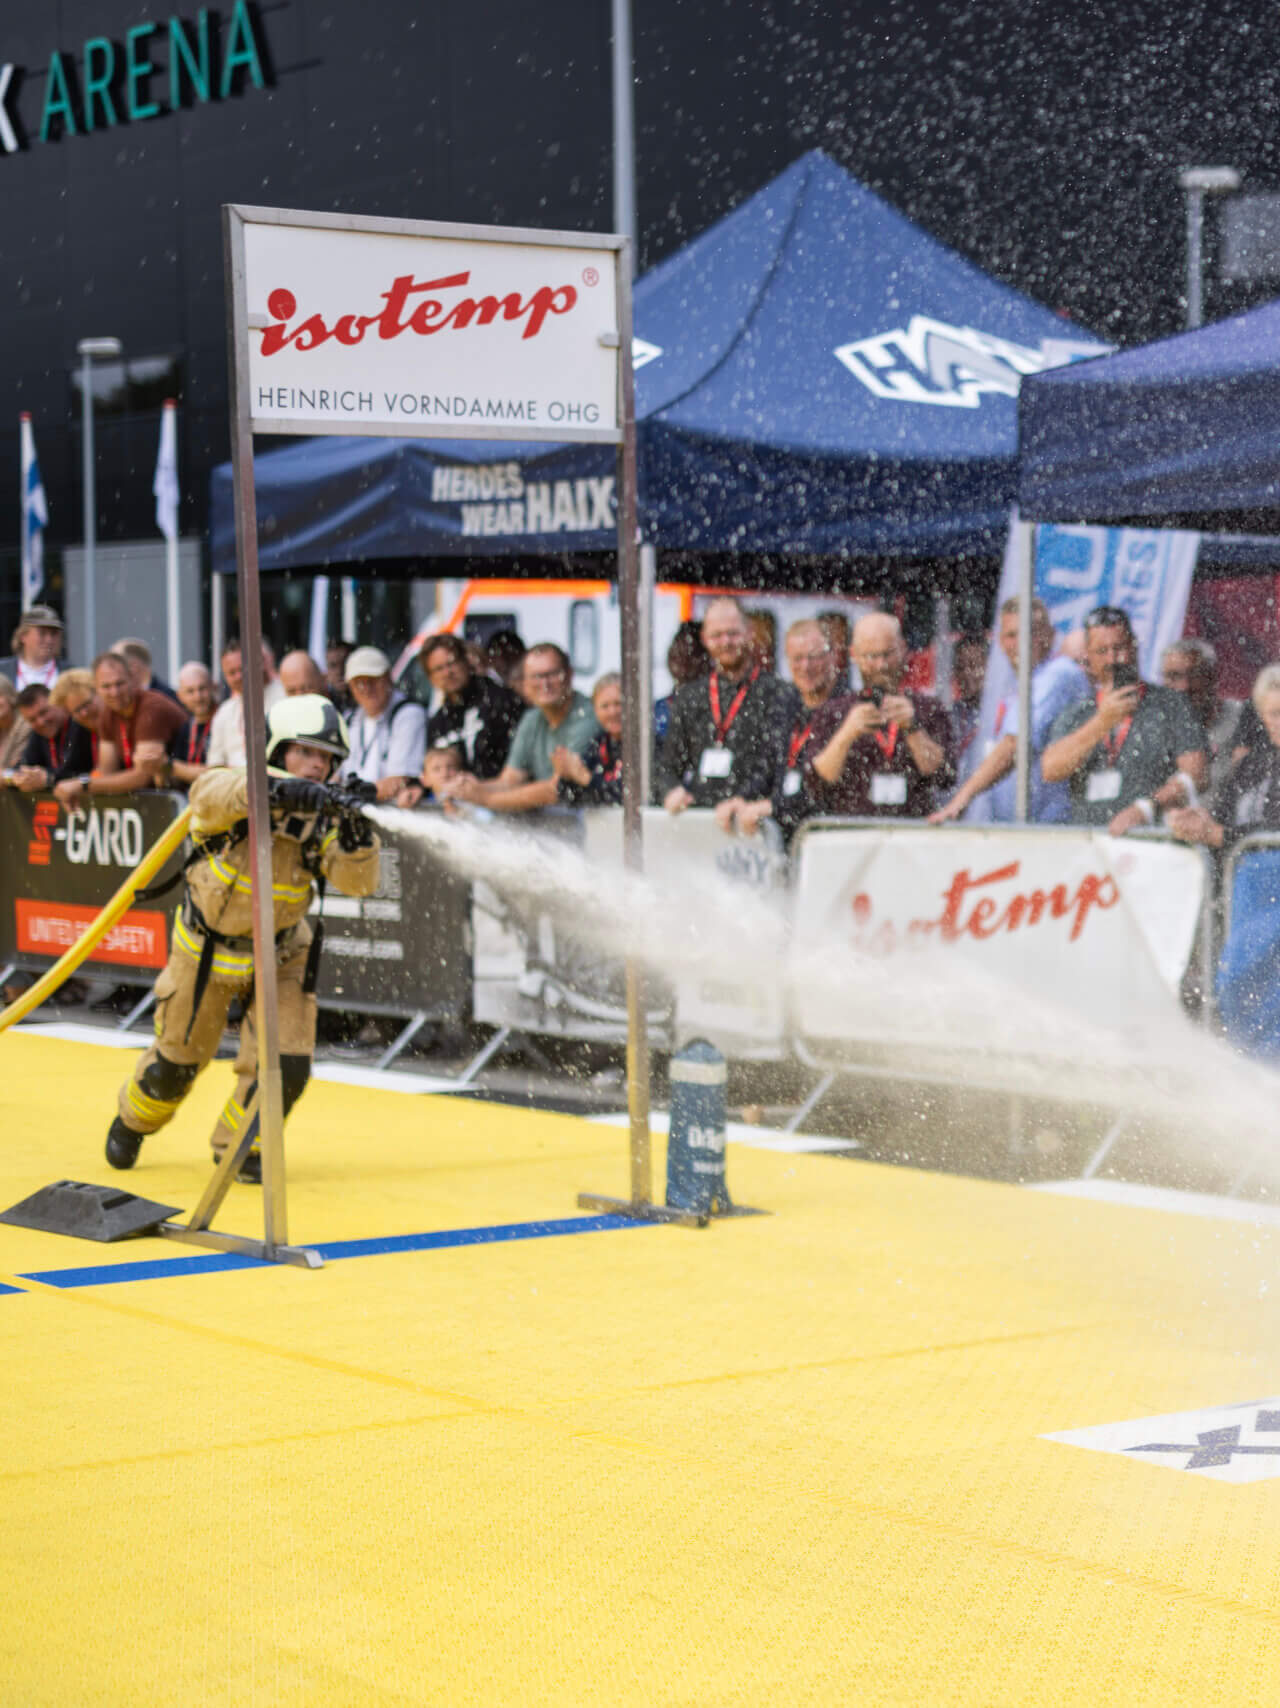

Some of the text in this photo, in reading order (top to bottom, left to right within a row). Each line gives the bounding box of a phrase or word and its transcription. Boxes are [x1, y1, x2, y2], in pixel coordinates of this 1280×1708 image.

[39, 0, 265, 143] ARENA
[258, 386, 601, 424] HEINRICH VORNDAMME OHG
[432, 462, 525, 502] HEROES
[461, 475, 616, 537] WEAR HAIX
[852, 859, 1121, 955] itemp
